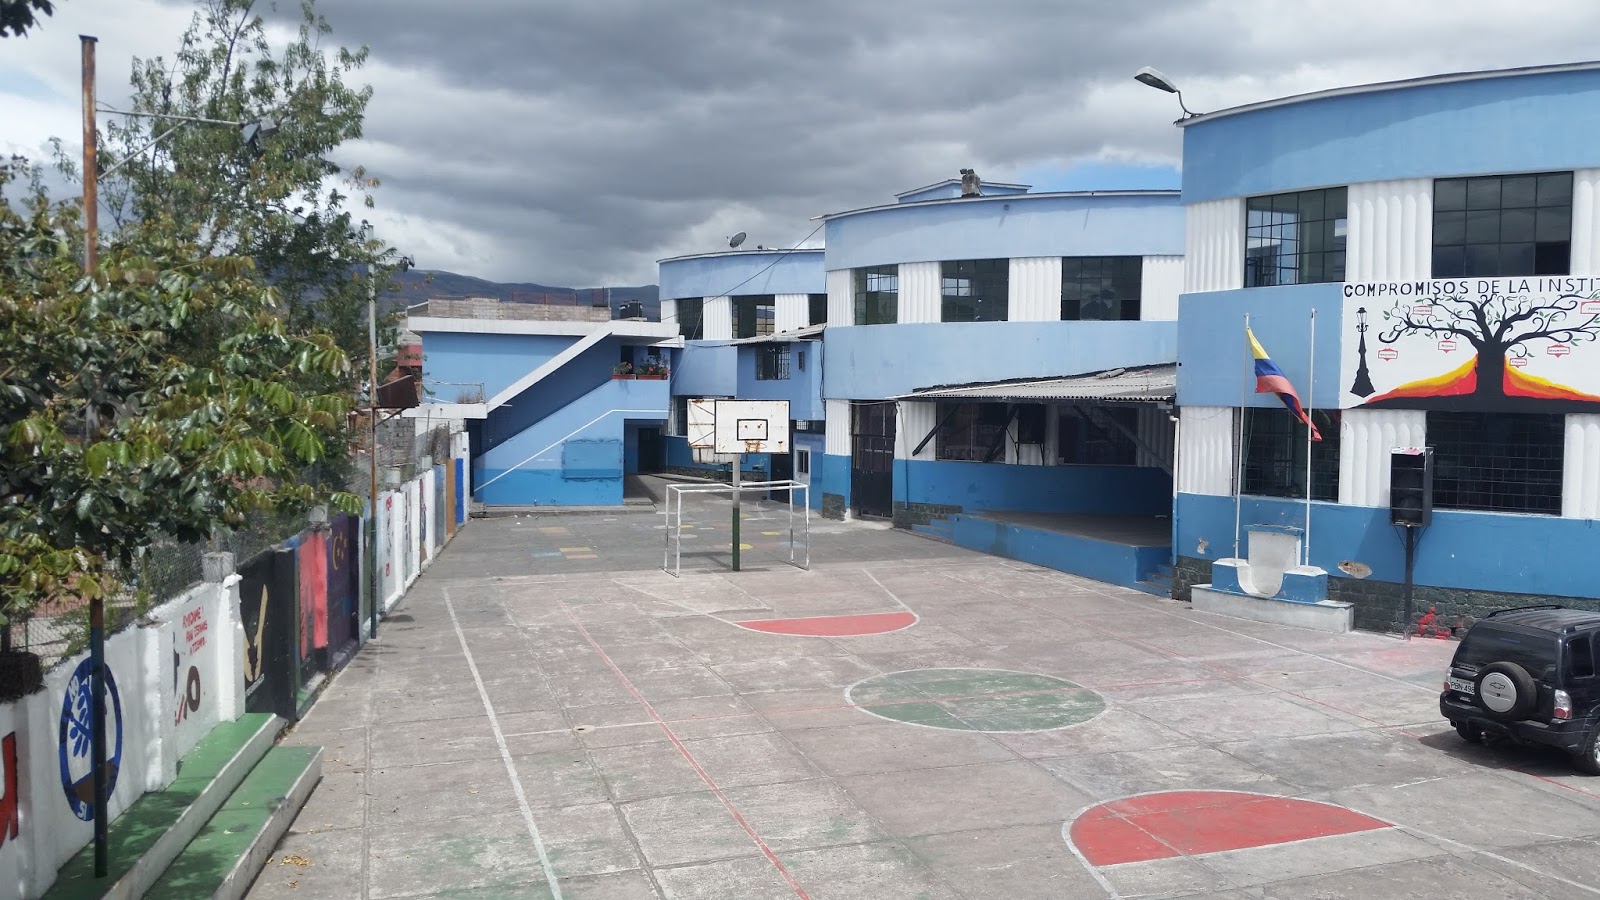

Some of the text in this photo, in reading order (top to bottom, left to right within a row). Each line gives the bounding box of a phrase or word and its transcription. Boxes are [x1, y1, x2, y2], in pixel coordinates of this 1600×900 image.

[1344, 281, 1469, 297] COMPROMISOS
[1478, 280, 1500, 294] DE
[1509, 279, 1530, 294] LA
[68, 675, 79, 702] NO
